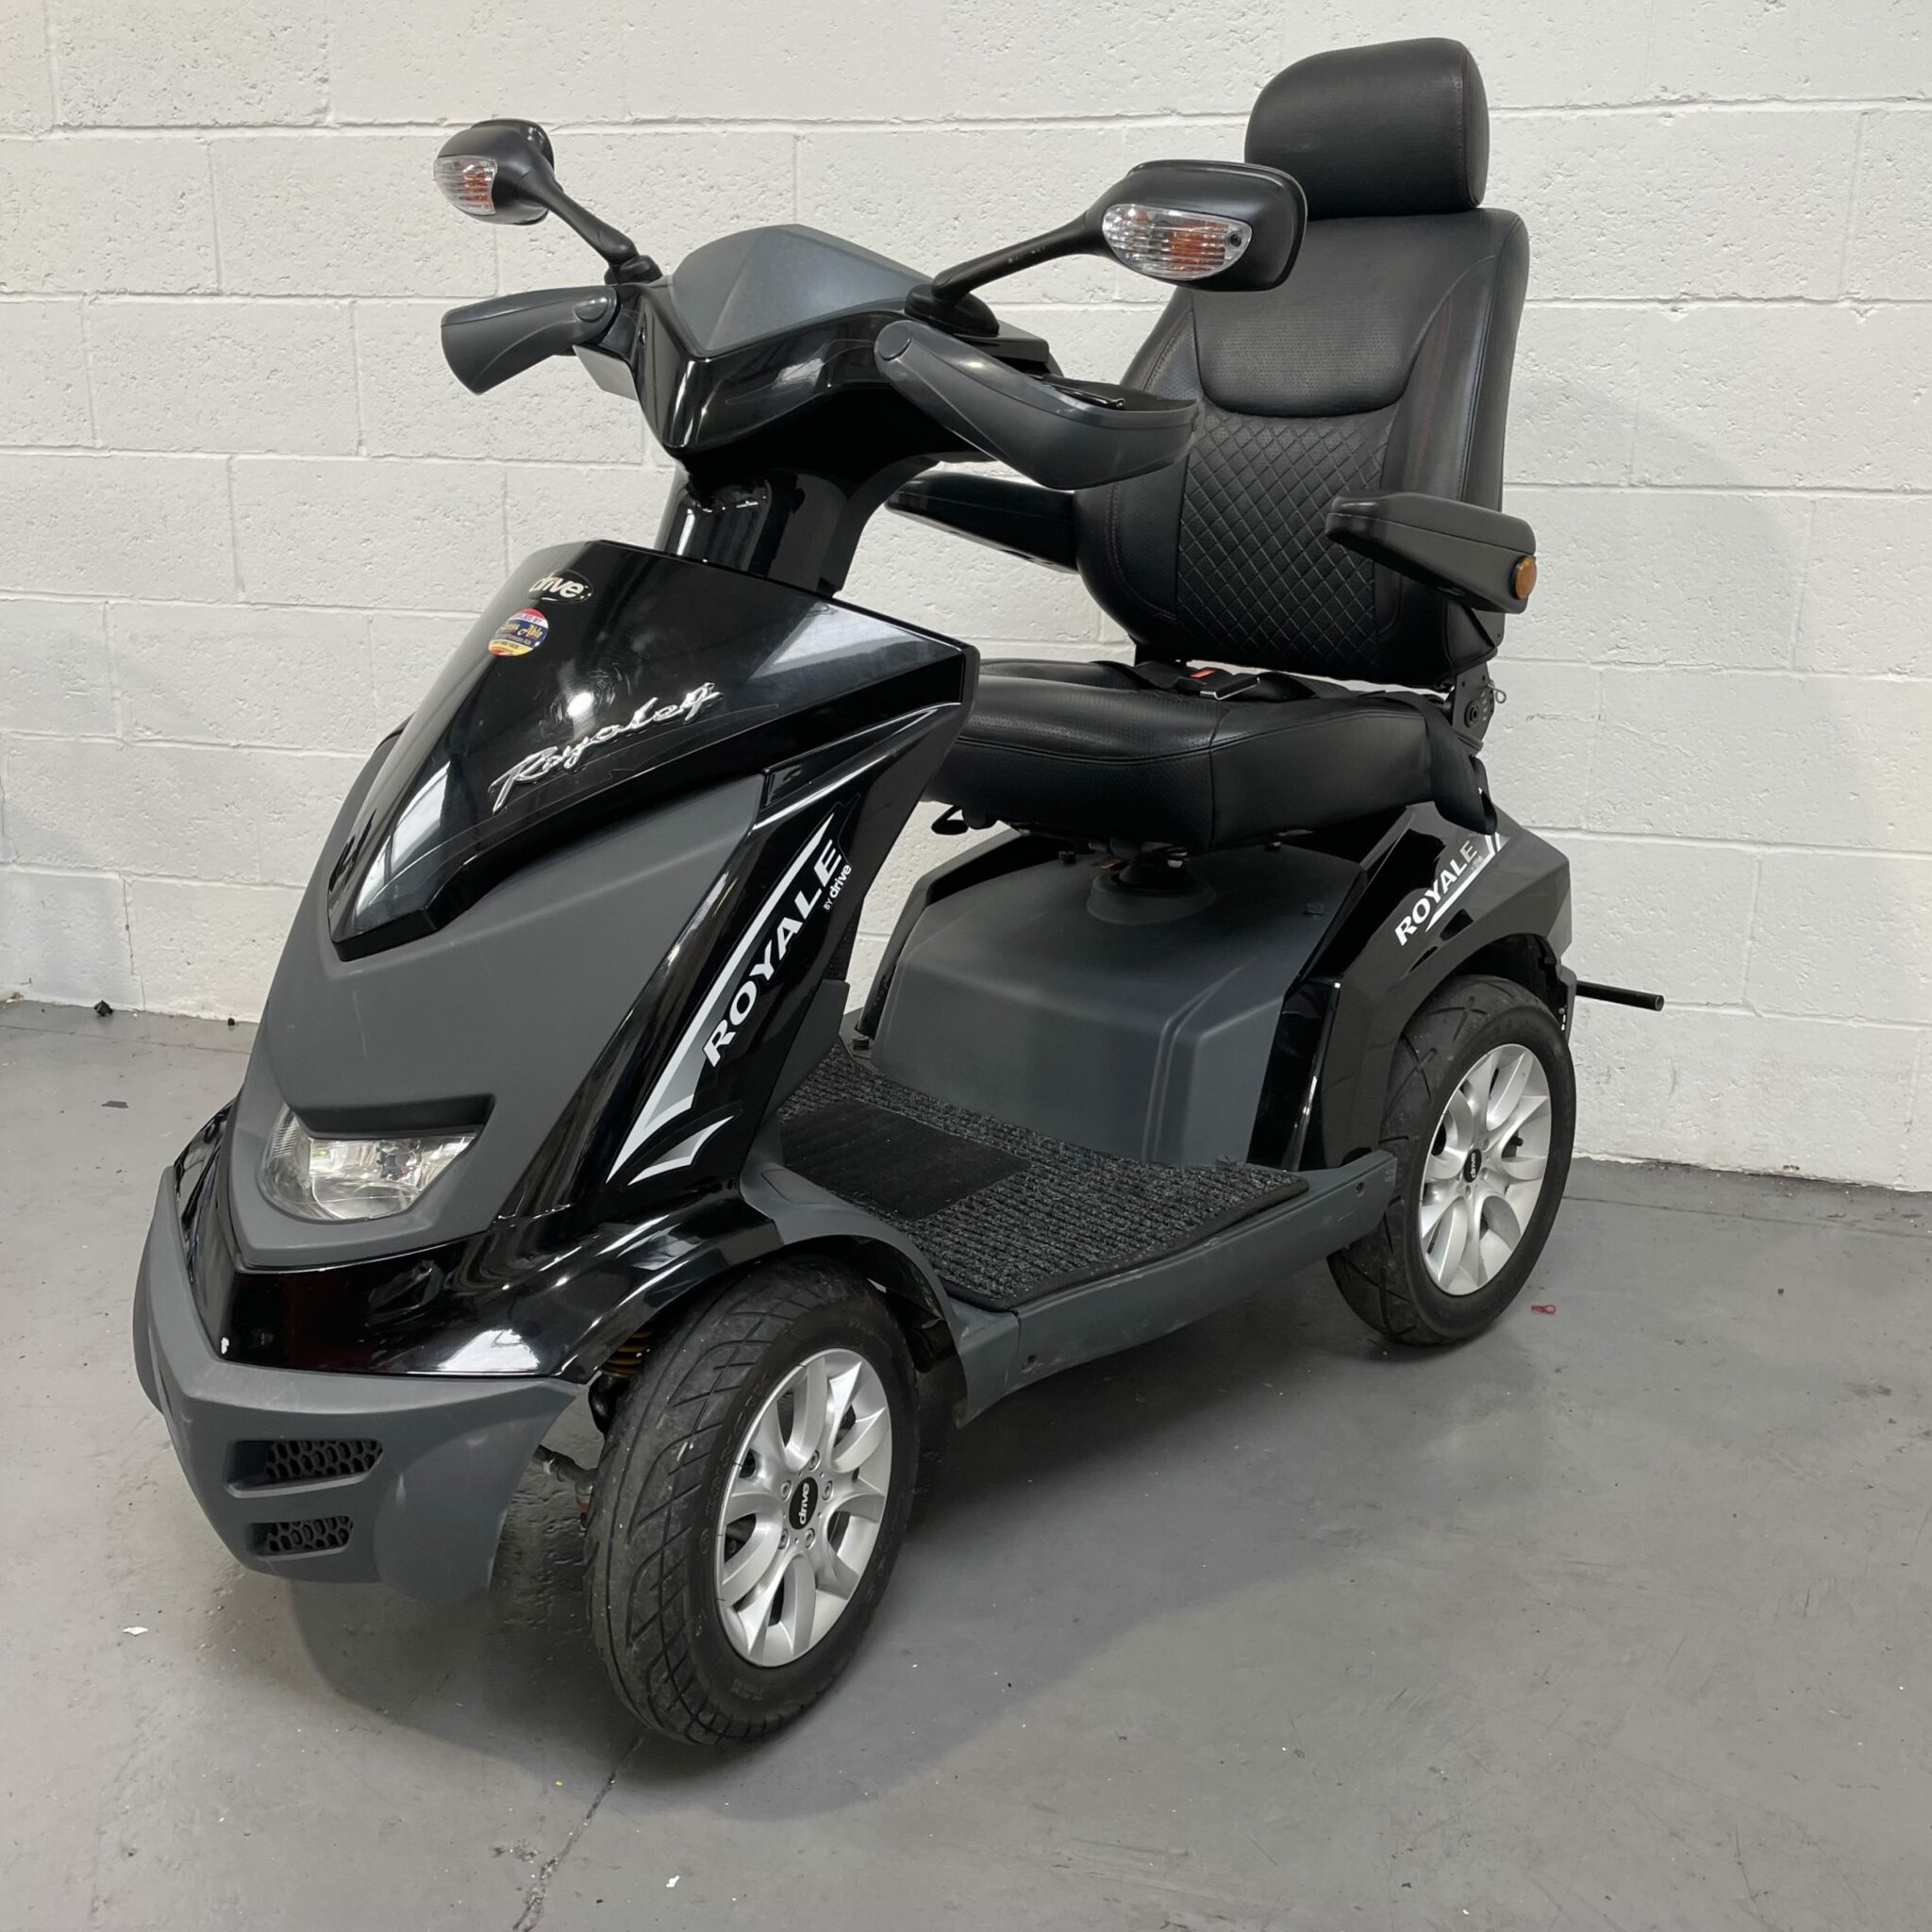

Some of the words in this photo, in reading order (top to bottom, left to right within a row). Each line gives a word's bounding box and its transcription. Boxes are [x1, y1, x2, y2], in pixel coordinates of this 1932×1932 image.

[529, 572, 585, 598] drive
[823, 897, 833, 910] BY
[829, 864, 852, 898] drive
[1394, 841, 1478, 946] ROYALE
[702, 839, 842, 1068] ROYALE
[798, 1482, 810, 1524] drive
